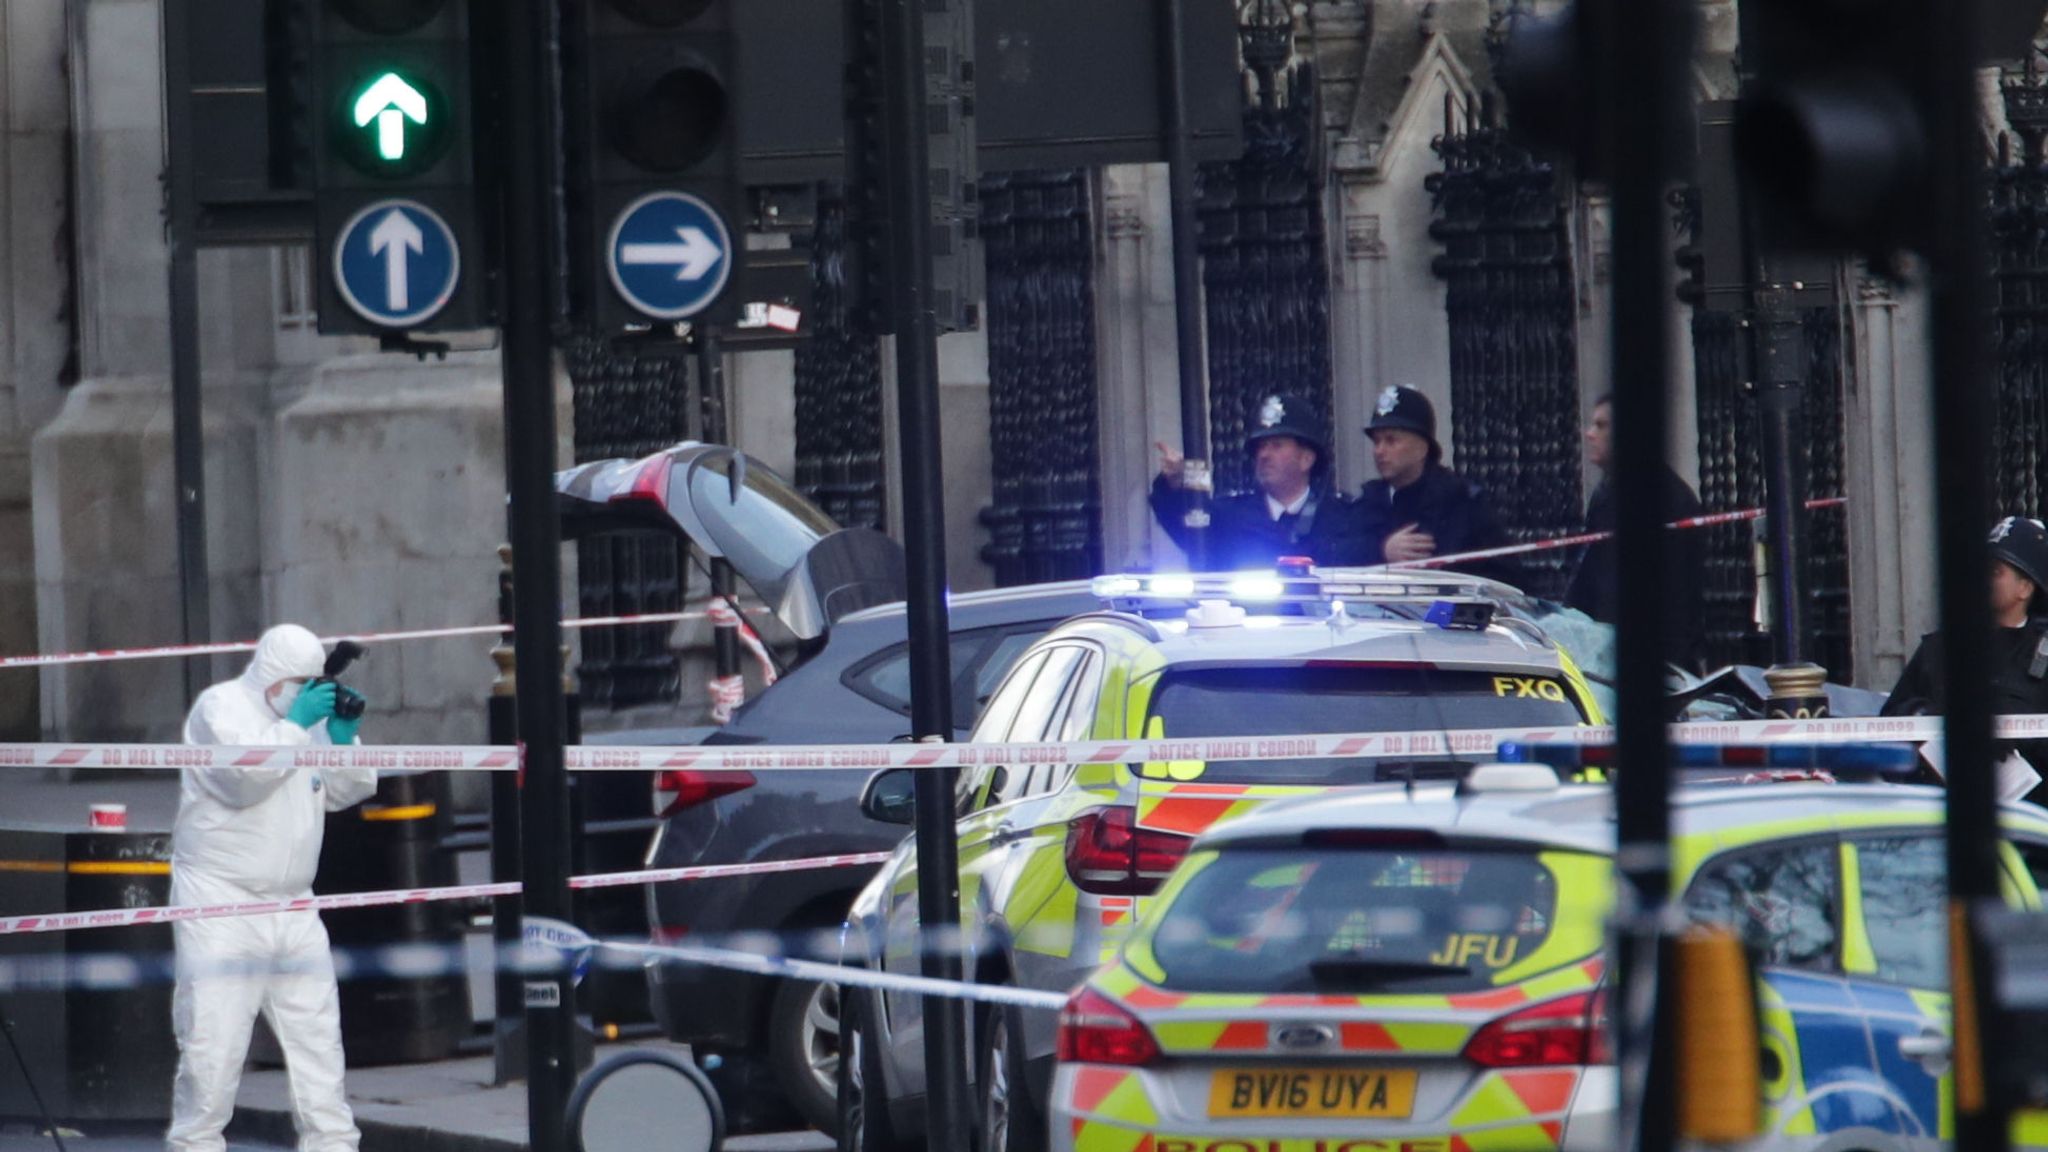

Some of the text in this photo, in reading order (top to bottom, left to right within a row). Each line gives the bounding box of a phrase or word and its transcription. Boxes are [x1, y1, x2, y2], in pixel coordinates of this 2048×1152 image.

[1492, 677, 1566, 703] FXQ
[1429, 932, 1519, 968] JFU
[1230, 1074, 1389, 1111] BV16 UYA
